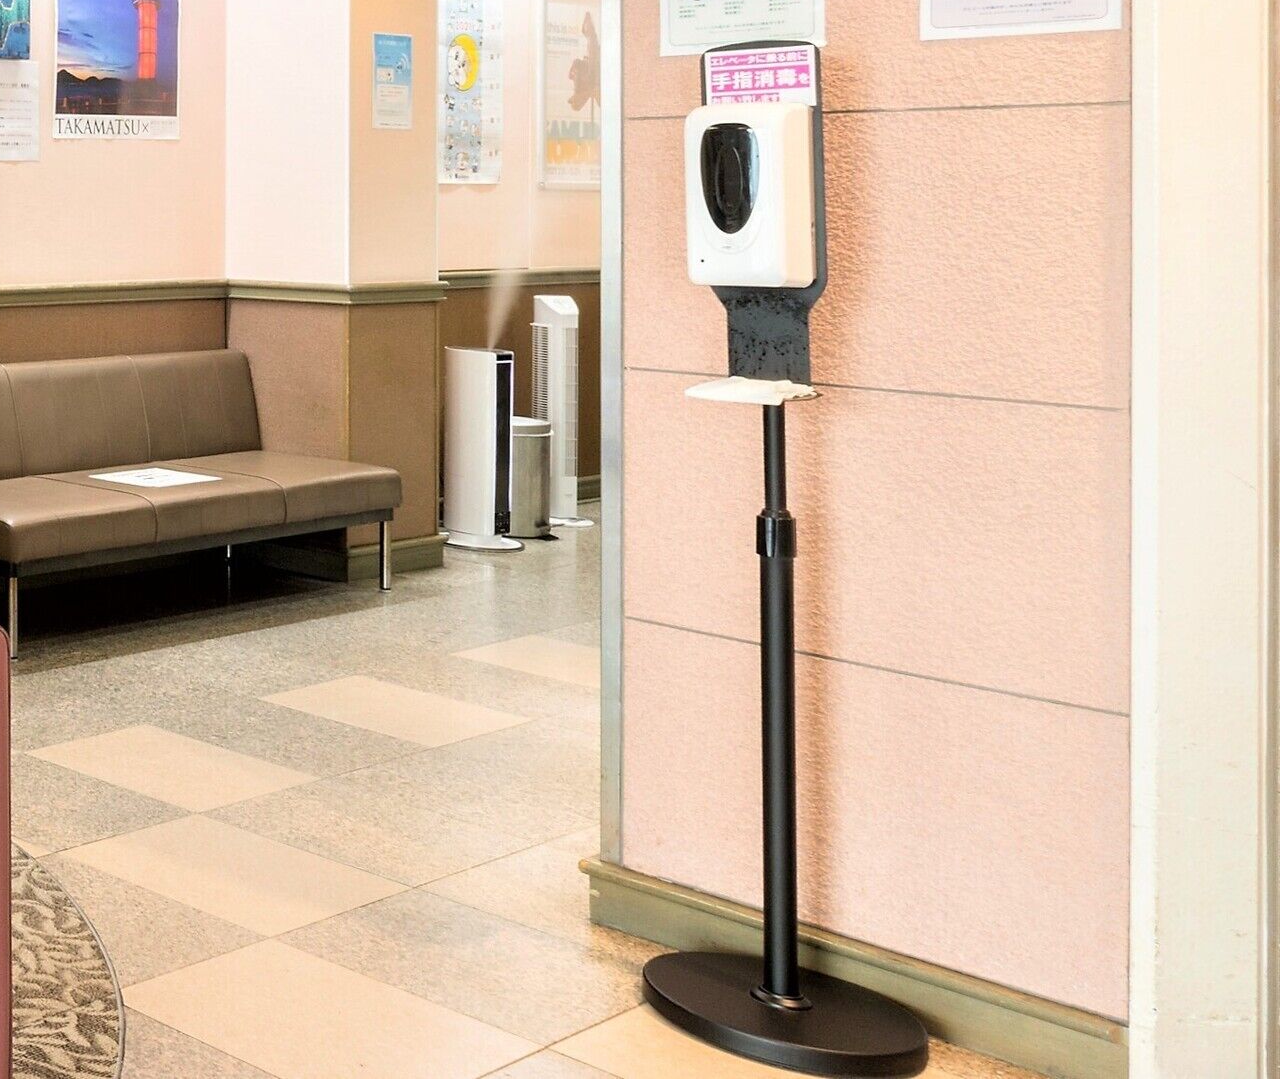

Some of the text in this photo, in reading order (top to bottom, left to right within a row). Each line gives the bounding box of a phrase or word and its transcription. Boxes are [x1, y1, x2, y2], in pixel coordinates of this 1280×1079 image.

[711, 69, 809, 91] 手指消毒を
[55, 118, 140, 136] TAKAMATSU
